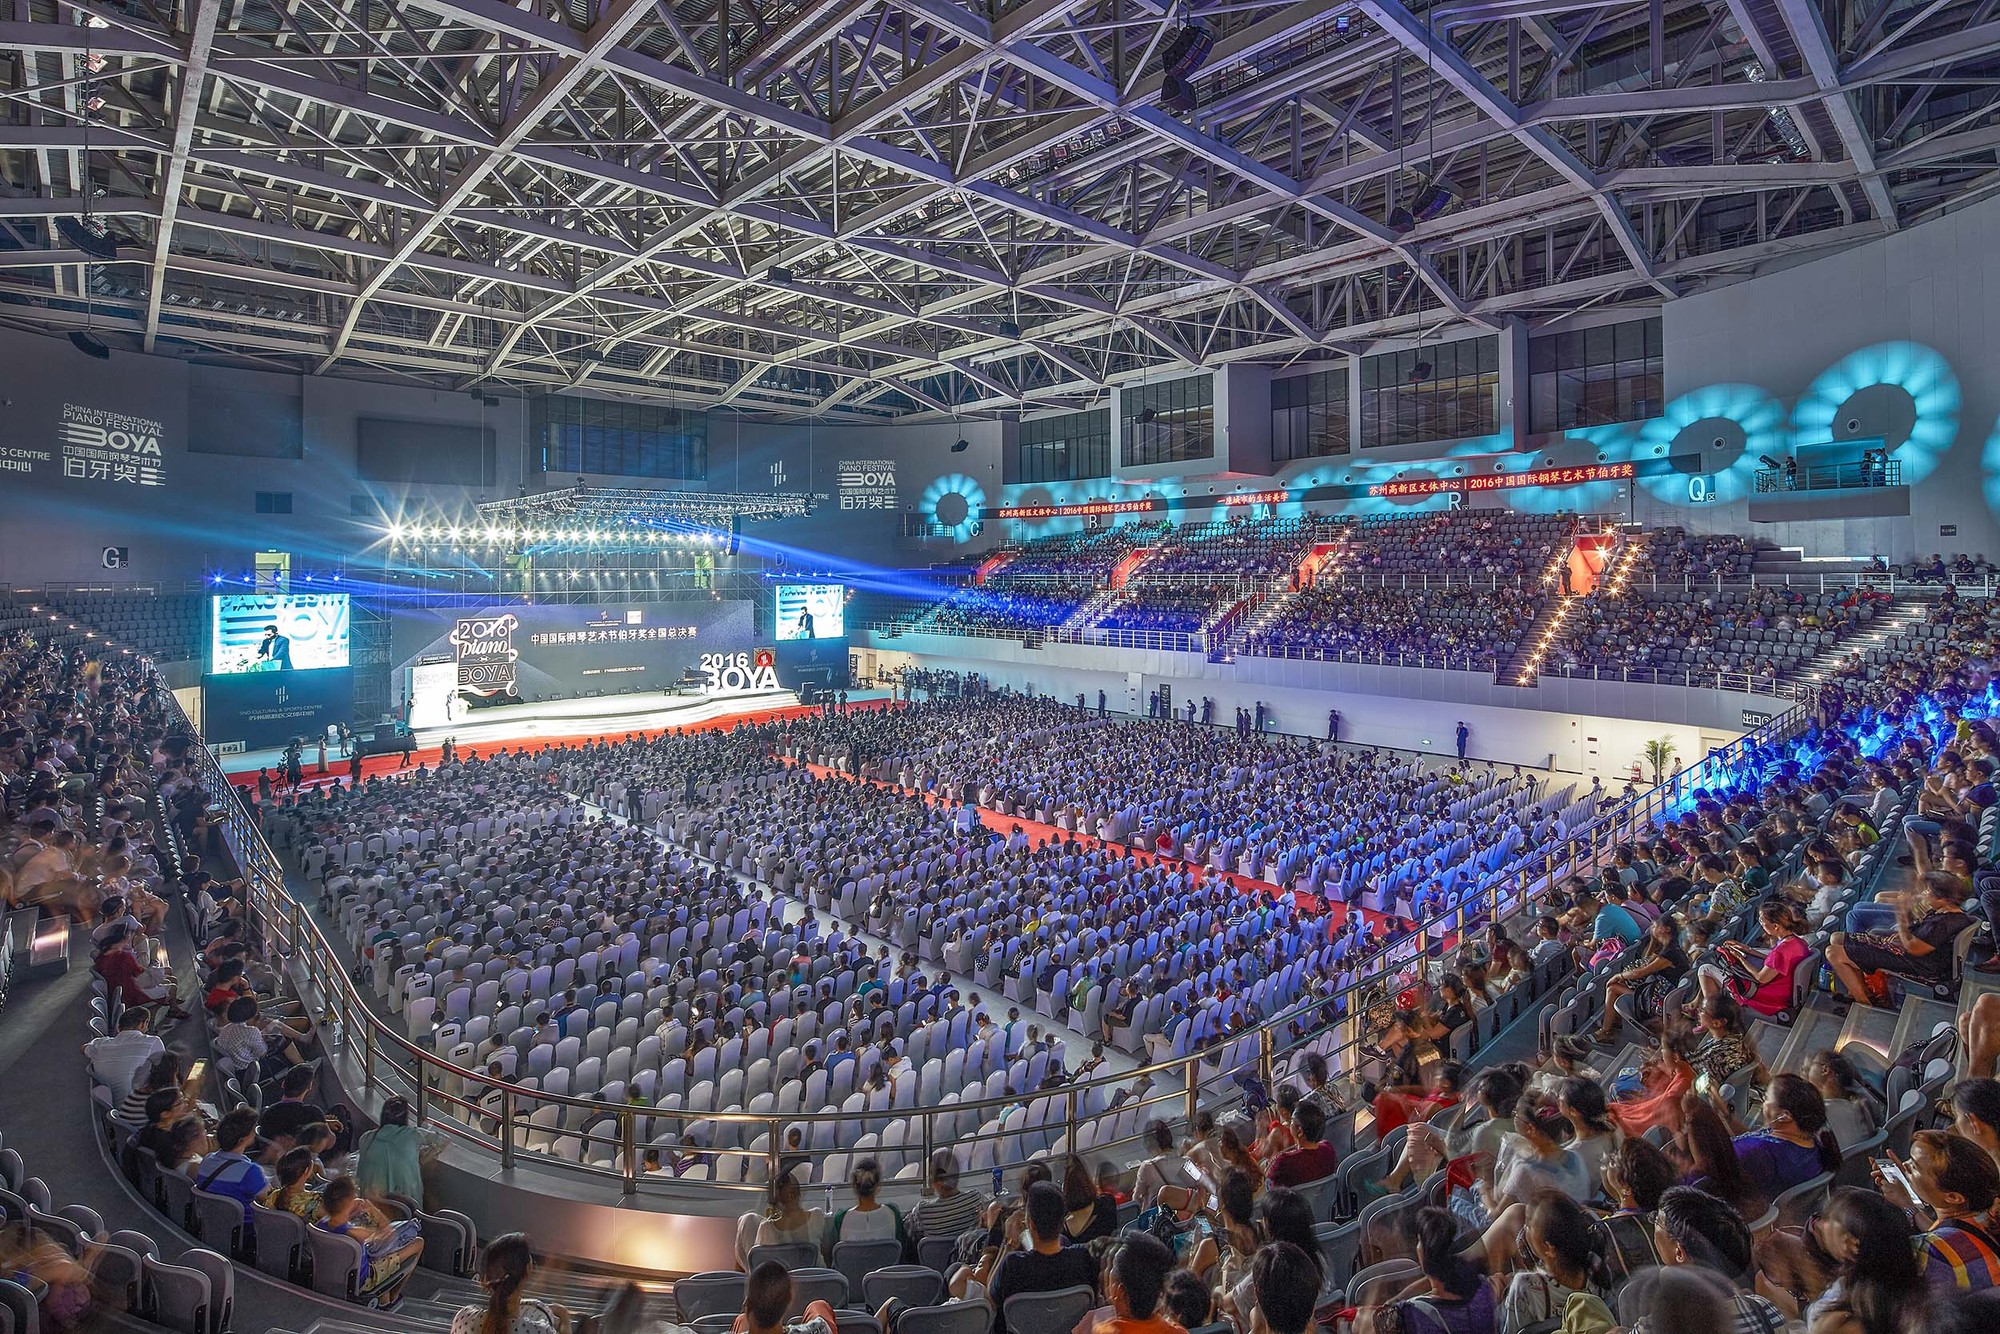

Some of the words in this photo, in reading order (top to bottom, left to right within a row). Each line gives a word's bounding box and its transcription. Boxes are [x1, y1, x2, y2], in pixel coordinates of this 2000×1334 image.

[64, 403, 92, 415] CHINA
[94, 409, 164, 429] INTERNATIONAL
[64, 411, 103, 426] PIANO
[106, 420, 164, 437] FESTIVAL
[59, 422, 161, 456] BOYA
[9, 448, 51, 461] CENTRE
[63, 457, 136, 484] 伯牙奖
[837, 473, 896, 487] BOYA
[1369, 481, 1460, 496] 苏州高新区文体中心
[1688, 476, 1706, 502] Q
[840, 496, 883, 510] 伯牙奖
[1448, 492, 1462, 511] R
[1261, 503, 1271, 520] A
[970, 522, 980, 537] C
[1089, 515, 1098, 529] B
[102, 547, 119, 569] G
[775, 552, 785, 566] D
[283, 594, 350, 608] FESTIV
[459, 622, 508, 639] 2016
[531, 626, 697, 645] 中国国际钢琴艺术节伯牙奖全国总决赛
[460, 639, 508, 659] piano
[700, 652, 749, 669] 2016
[458, 664, 511, 685] BOYA
[700, 667, 781, 692] BOYA
